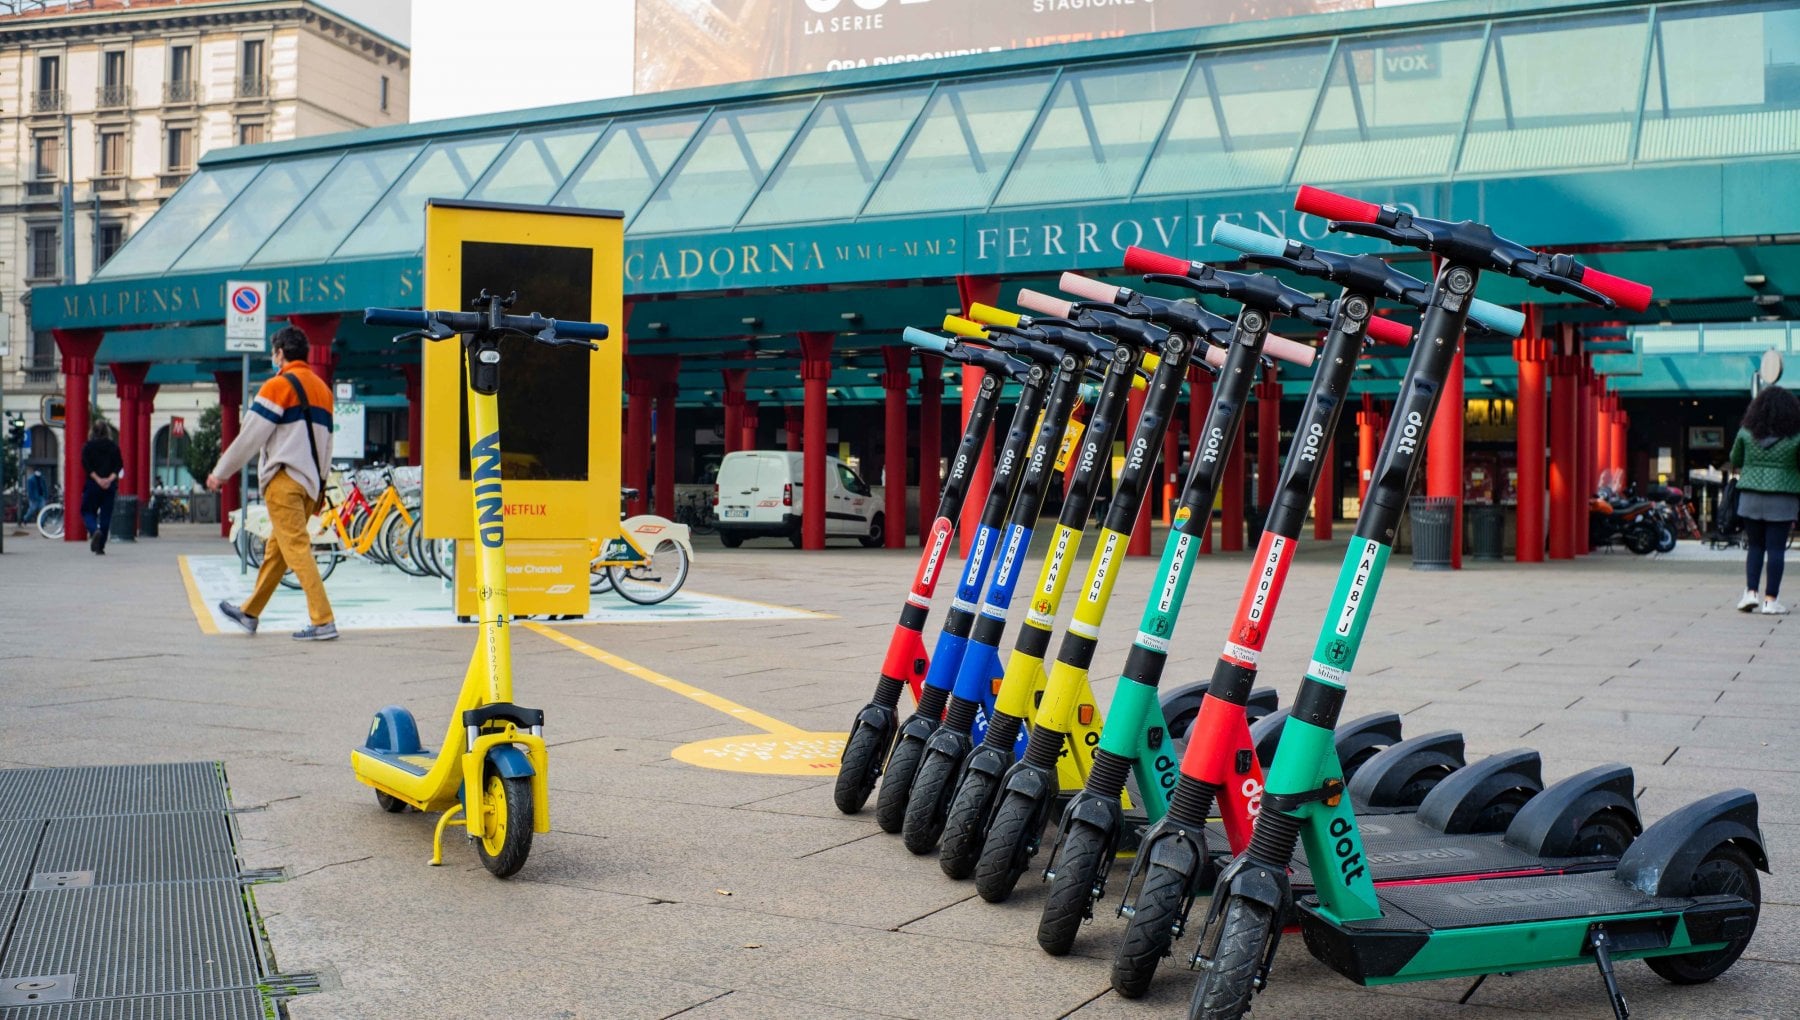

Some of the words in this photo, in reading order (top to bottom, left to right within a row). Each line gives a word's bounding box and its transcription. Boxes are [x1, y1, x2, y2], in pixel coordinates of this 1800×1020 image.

[804, 19, 825, 35] LA
[830, 14, 884, 32] SERIE
[625, 242, 826, 281] CADORNA
[63, 286, 201, 318] MALPENSA
[1202, 427, 1223, 463] dott
[1301, 423, 1324, 462] dott
[1397, 411, 1423, 455] dott
[953, 454, 967, 479] dott
[1000, 449, 1016, 476] dott
[1031, 445, 1047, 473] dott
[1080, 442, 1097, 472] dott
[1129, 437, 1148, 470] dott
[471, 430, 505, 548] WIND
[504, 504, 546, 516] NETFLIX
[1046, 529, 1071, 592] WQWAN8
[1089, 534, 1117, 601] PPFSQH
[1161, 536, 1188, 611] 8K631E
[1251, 538, 1283, 619] F3802D
[1338, 543, 1377, 633] RAE87J
[1329, 817, 1366, 887] dott
